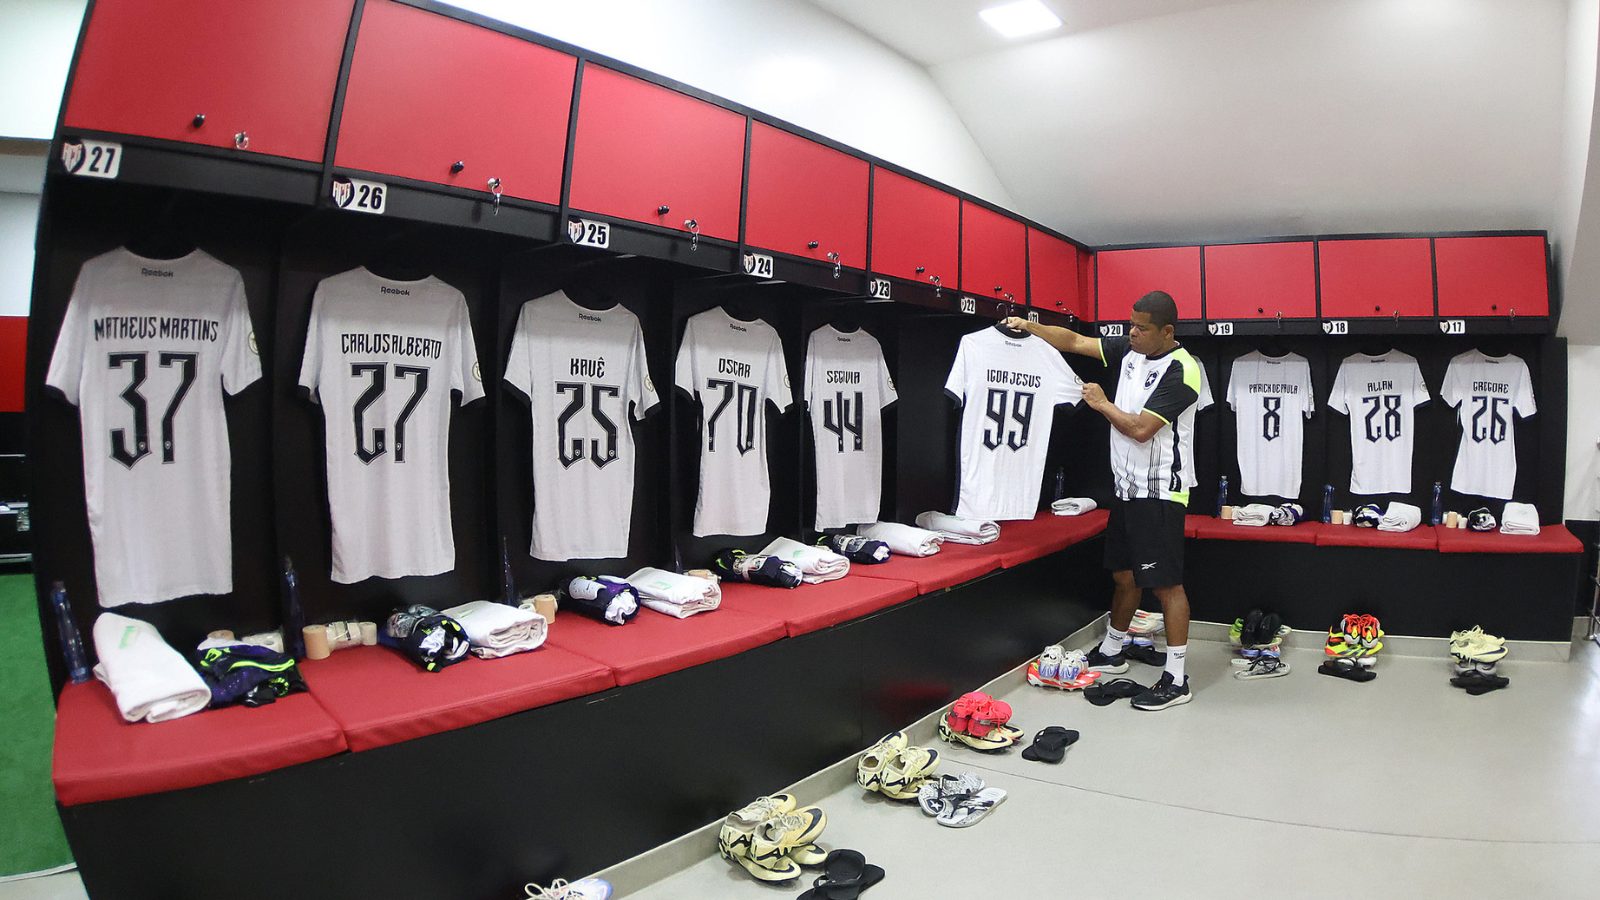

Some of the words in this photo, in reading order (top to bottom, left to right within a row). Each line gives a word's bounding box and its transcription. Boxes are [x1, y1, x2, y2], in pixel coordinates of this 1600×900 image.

[89, 146, 116, 174] 27
[358, 185, 383, 210] 26
[587, 224, 607, 245] 25
[141, 268, 174, 277] Reebok
[757, 257, 771, 275] 24
[381, 286, 410, 296] Reebok
[879, 281, 890, 297] 23
[966, 299, 974, 312] 22
[578, 313, 602, 322] Reebok
[730, 323, 747, 332] Reebok
[1335, 322, 1346, 333] 18
[1452, 321, 1462, 333] 17
[94, 316, 157, 341] MATHEUS
[160, 317, 219, 342] MARTINS
[1111, 325, 1121, 335] 20
[1220, 323, 1231, 334] 19
[341, 334, 390, 355] CARLOS
[392, 335, 443, 360] ALBERTO
[718, 357, 752, 378] OSCAR
[986, 368, 1009, 384] IGOR
[1009, 371, 1042, 389] JESUS
[1367, 380, 1393, 393] ALLAN
[1473, 381, 1509, 394] GREGORE
[107, 351, 199, 470] 37
[350, 362, 431, 465] 27
[706, 377, 759, 457] 70
[983, 387, 1036, 452] 99
[1262, 397, 1281, 442] 8
[1362, 395, 1402, 444] 28
[1471, 395, 1509, 445] 26
[555, 380, 621, 470] 25
[823, 390, 864, 453] 44
